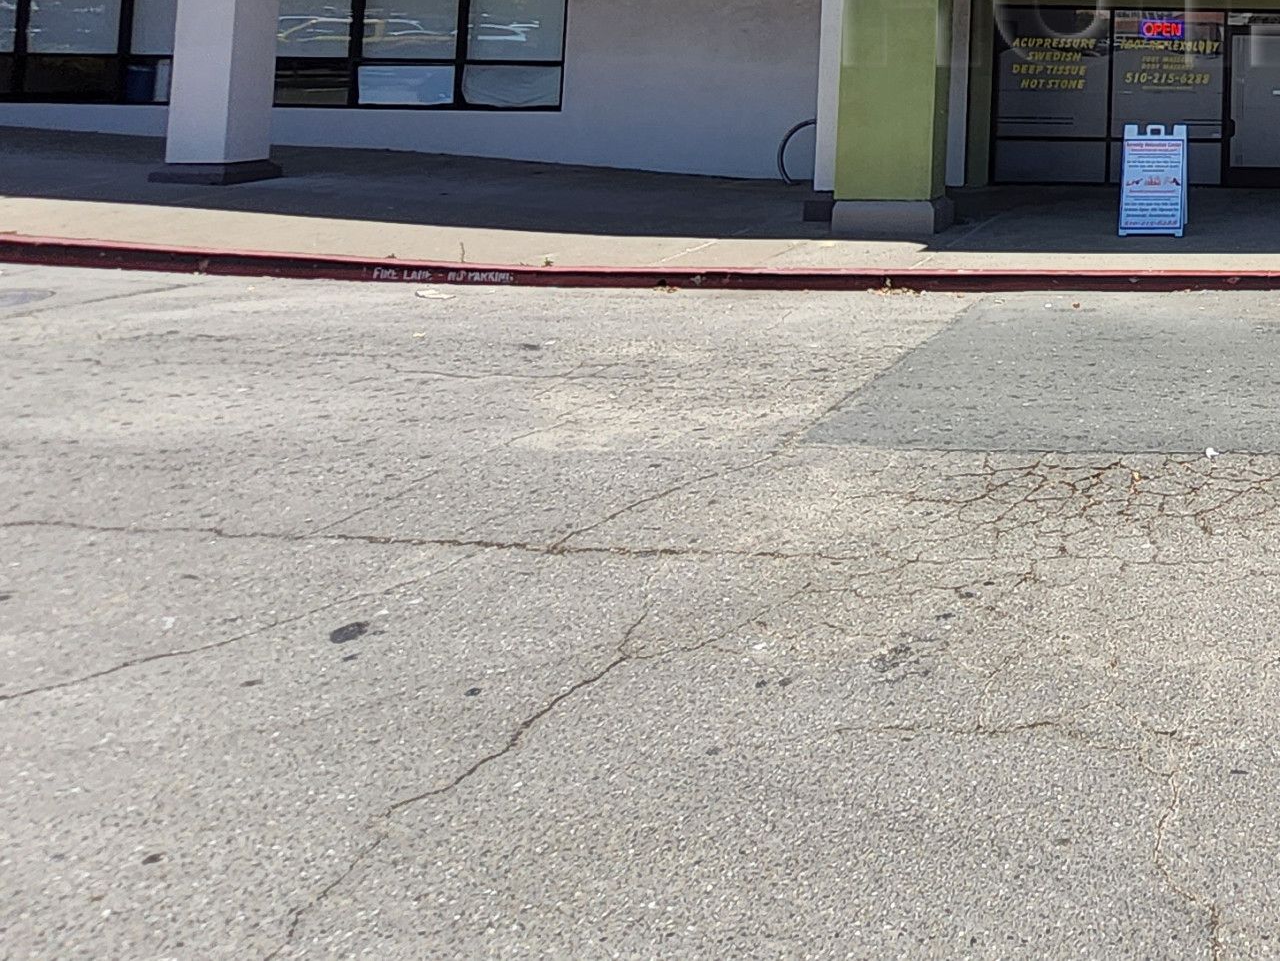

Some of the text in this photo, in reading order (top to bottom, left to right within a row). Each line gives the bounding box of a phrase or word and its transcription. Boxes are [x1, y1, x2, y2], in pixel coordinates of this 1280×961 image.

[1142, 21, 1183, 37] OPEN
[1012, 38, 1097, 49] ACUPRESSURE
[1027, 51, 1082, 61] SWEDISH
[1012, 64, 1087, 76] DEEP TISSUE
[1124, 72, 1210, 84] 510-215-6288
[1020, 79, 1085, 89] HOT STONE
